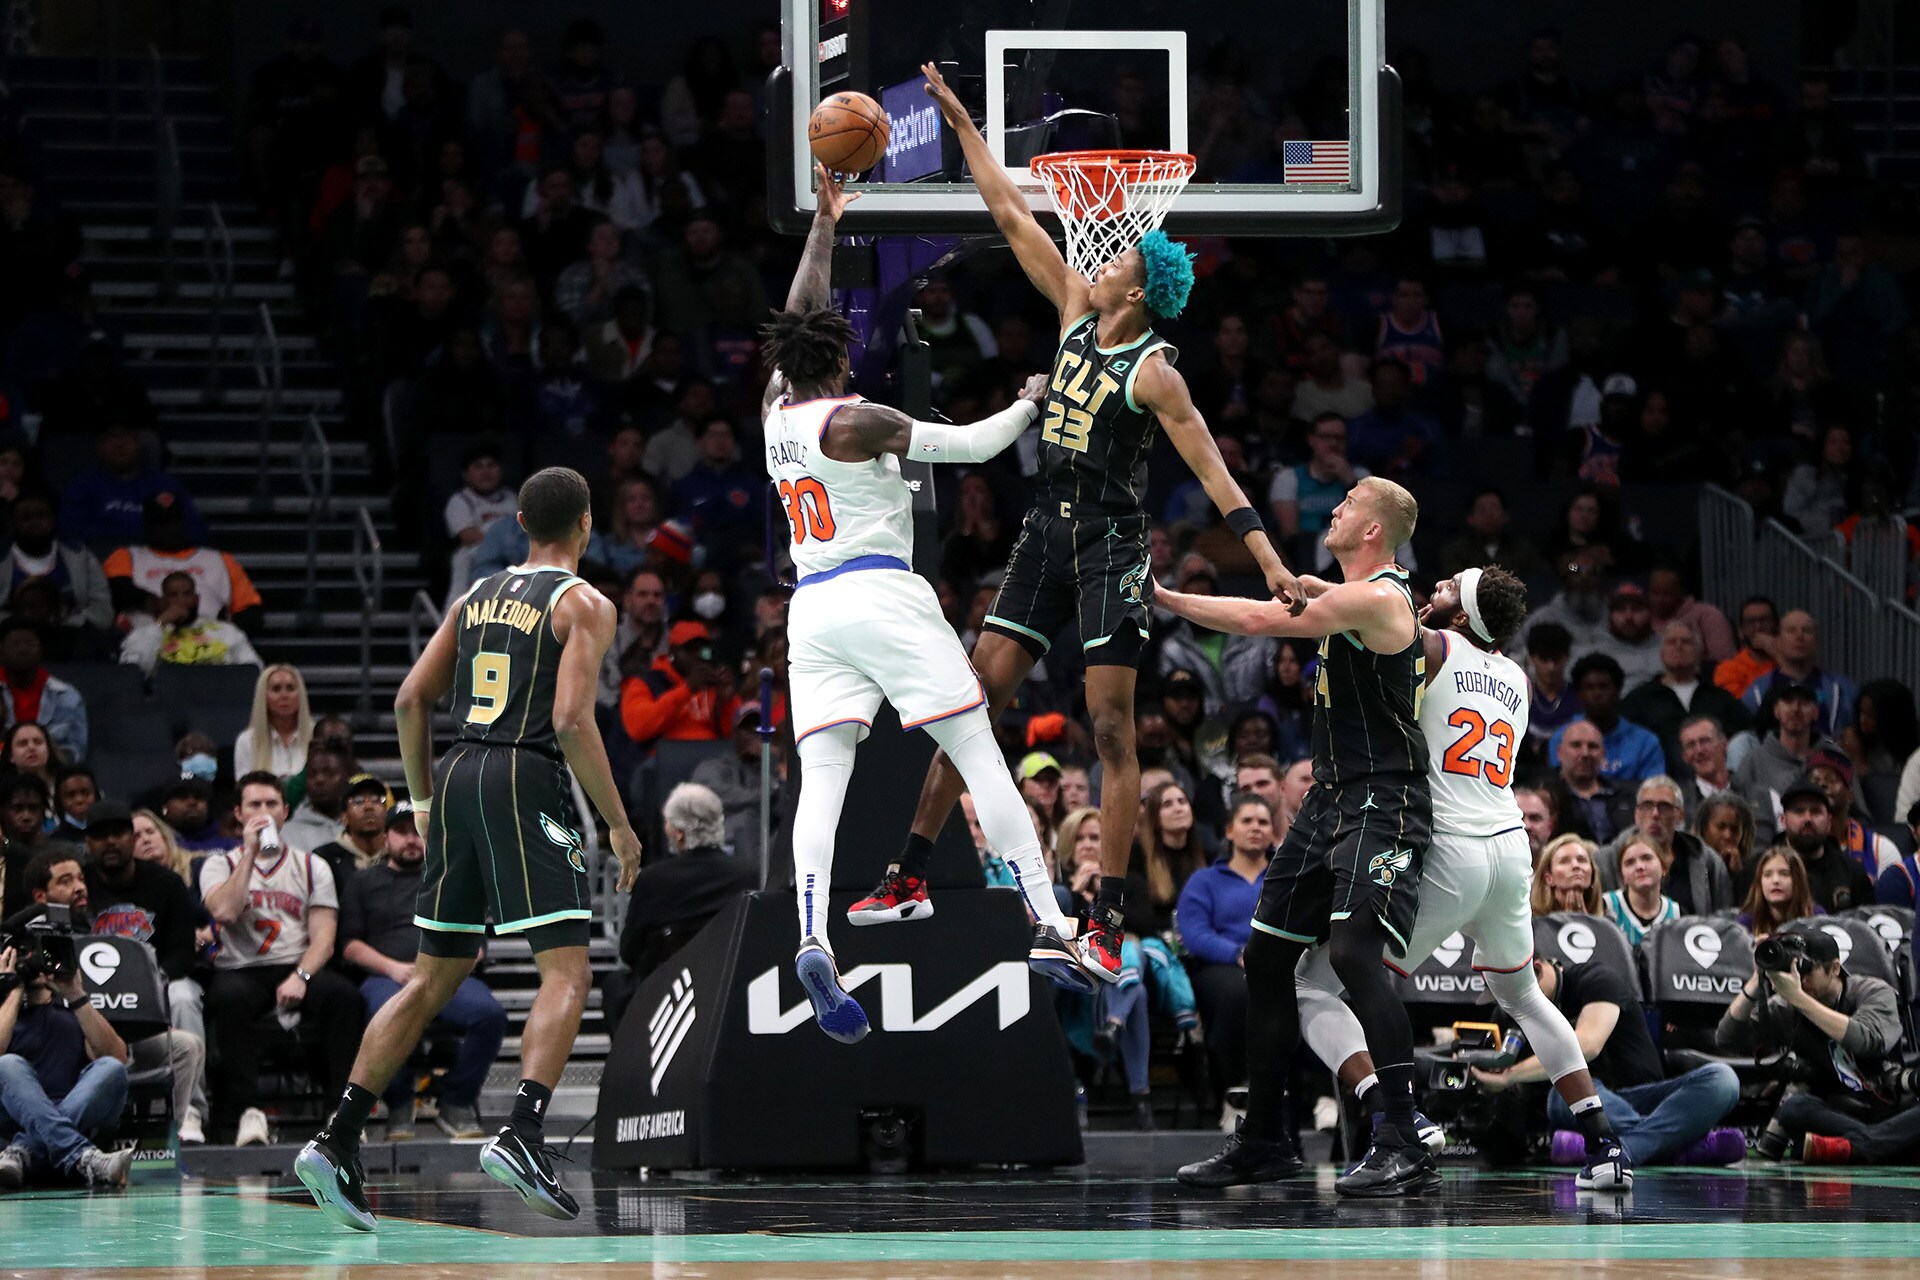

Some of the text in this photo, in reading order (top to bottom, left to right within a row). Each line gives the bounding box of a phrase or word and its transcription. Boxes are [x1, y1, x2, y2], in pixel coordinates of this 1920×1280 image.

[886, 104, 937, 167] Spectrum
[1051, 350, 1121, 415] CLT
[1042, 401, 1094, 453] 23
[779, 476, 837, 545] 30
[466, 599, 542, 635] MALEDON
[466, 652, 511, 725] 9
[1454, 670, 1522, 715] ROBINSON
[1442, 706, 1515, 789] 23
[255, 919, 281, 955] 7
[1414, 974, 1485, 992] wave
[1672, 973, 1743, 994] wave
[616, 1110, 685, 1143] BANK OF AMERICA
